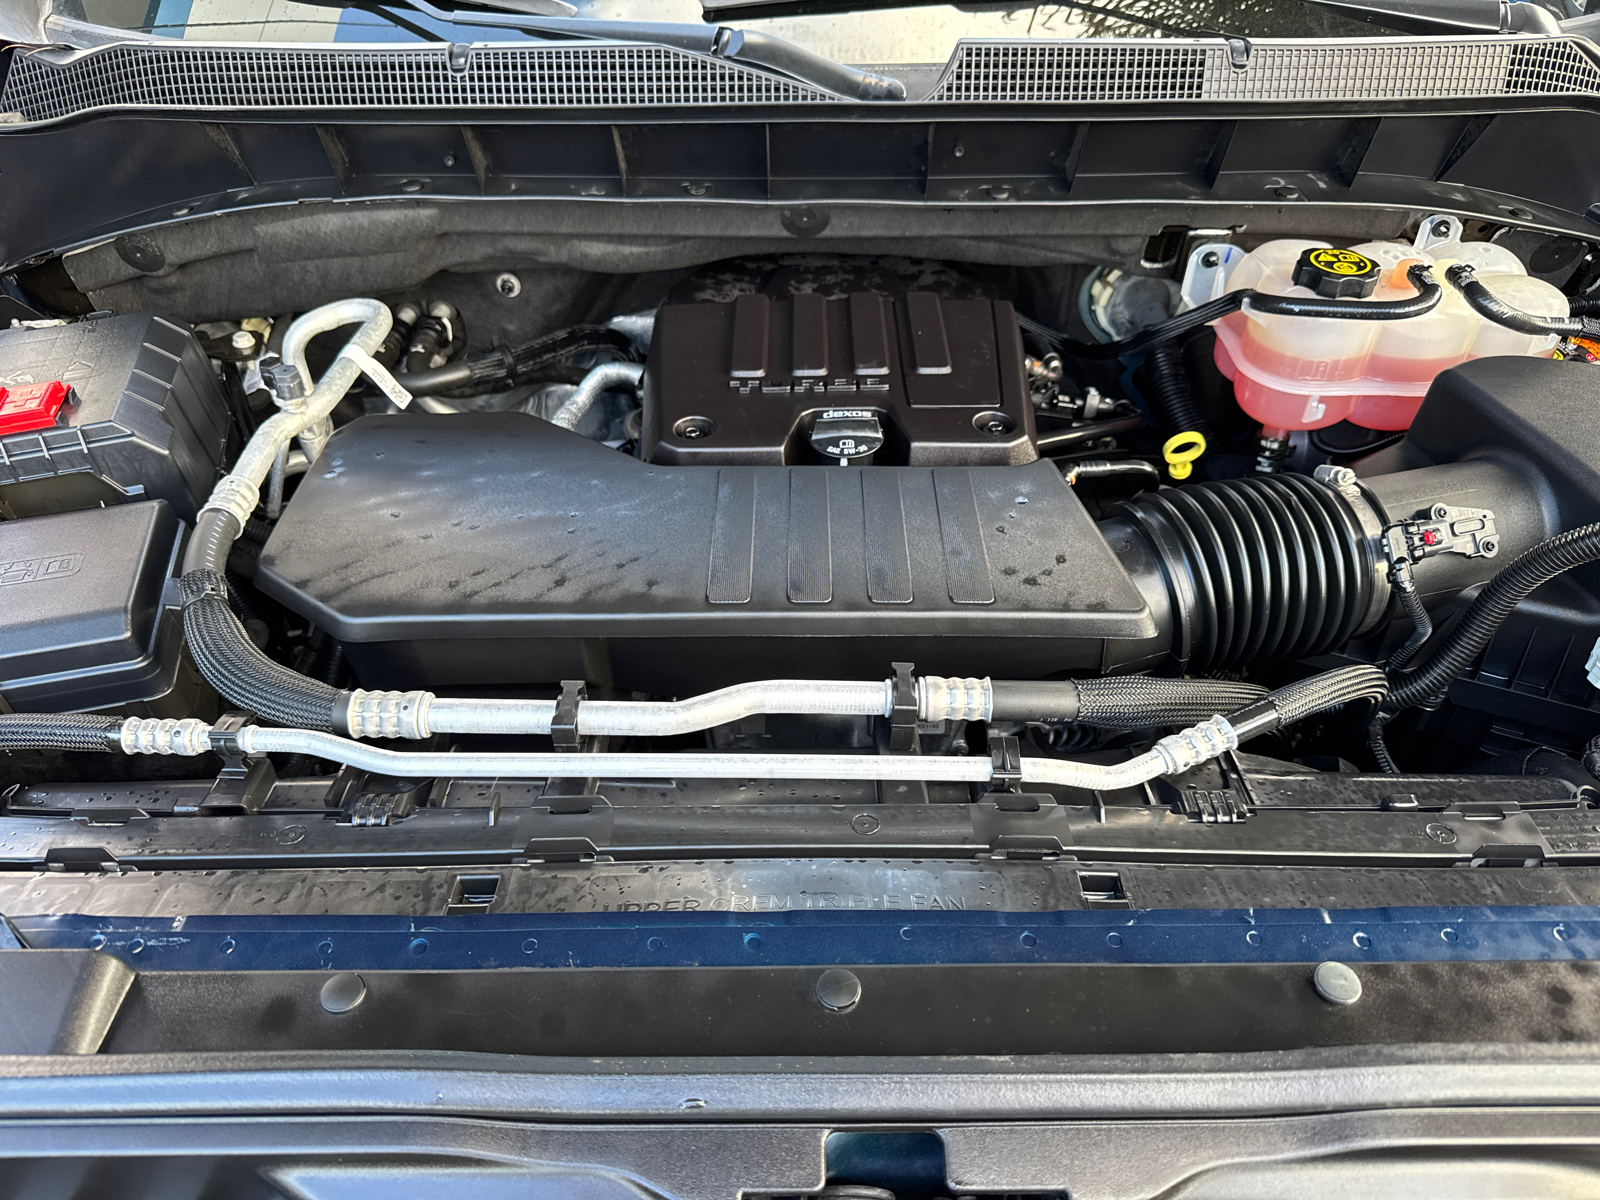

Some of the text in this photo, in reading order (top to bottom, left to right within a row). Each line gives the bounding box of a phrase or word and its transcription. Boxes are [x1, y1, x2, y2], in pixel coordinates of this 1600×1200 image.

[823, 410, 872, 419] dexos
[826, 444, 868, 455] SAE 5W-30
[800, 890, 901, 910] TRIPLE
[910, 893, 966, 910] FAN
